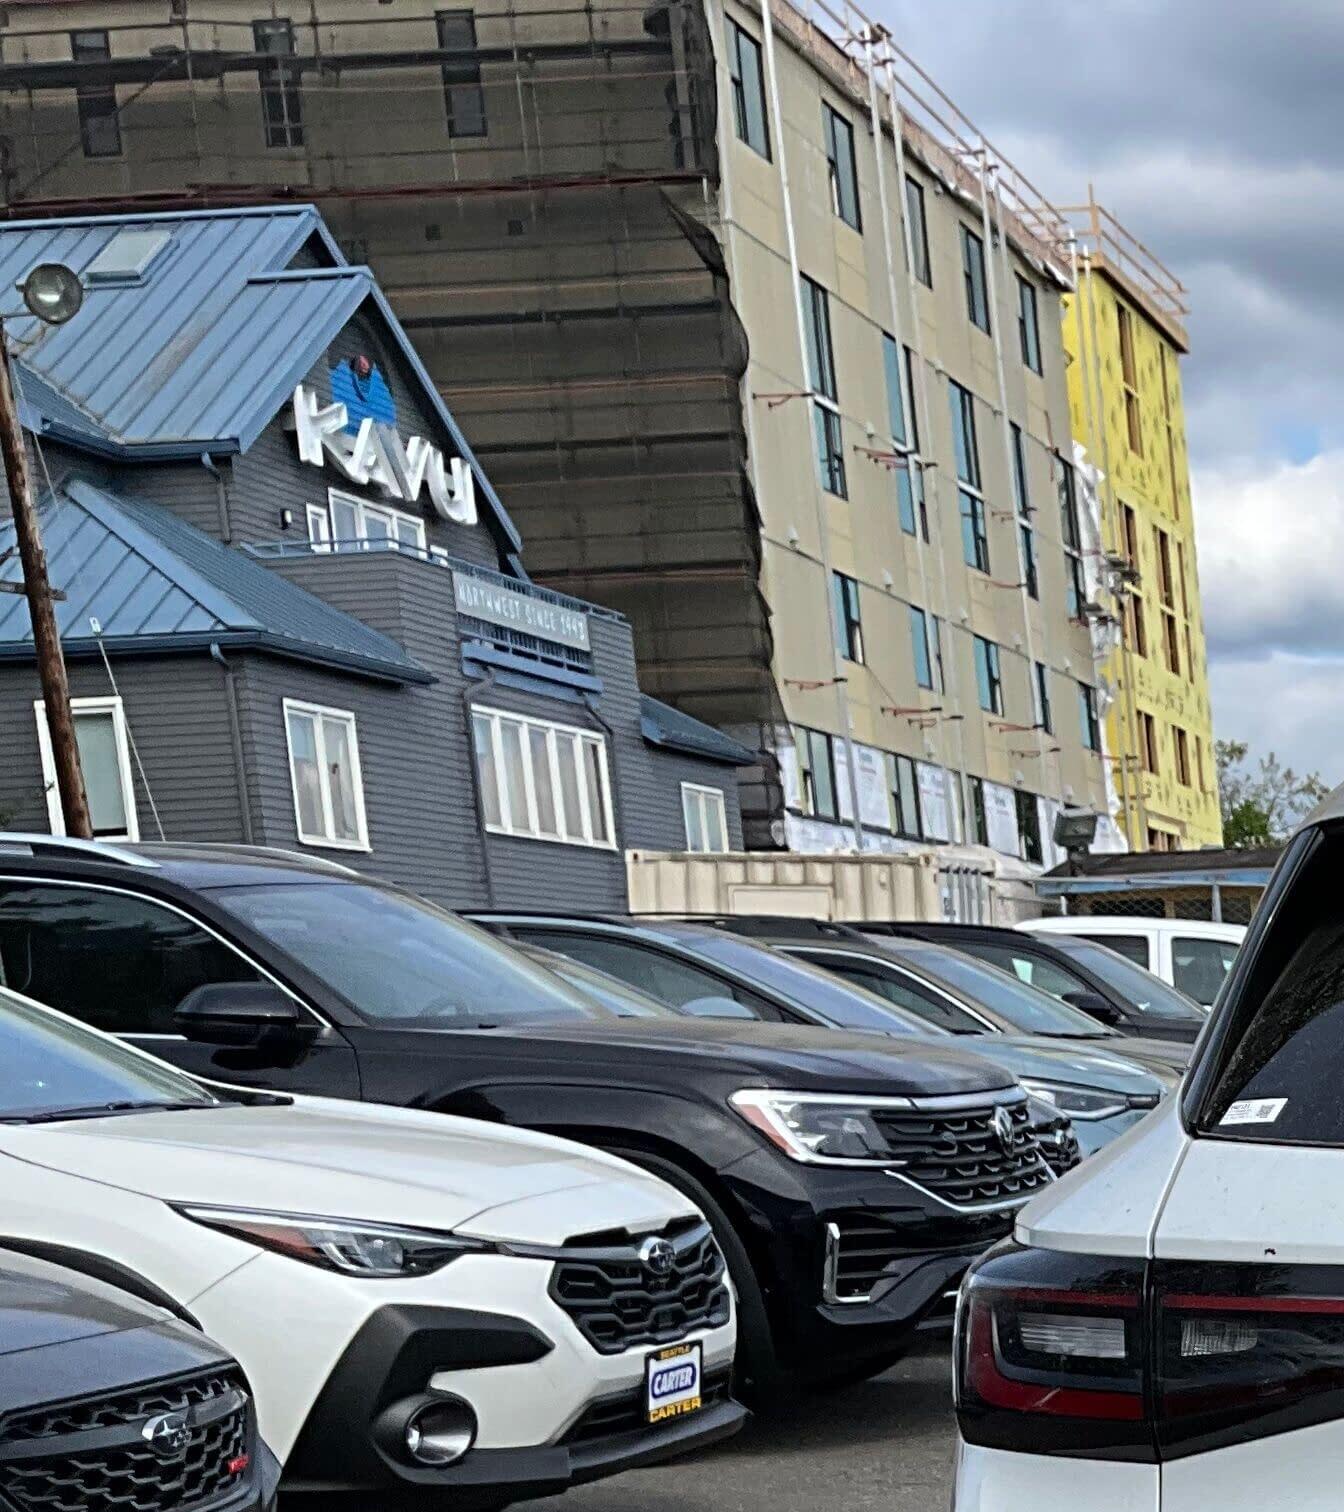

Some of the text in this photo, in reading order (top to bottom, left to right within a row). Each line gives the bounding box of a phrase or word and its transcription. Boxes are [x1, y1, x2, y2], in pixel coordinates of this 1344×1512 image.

[293, 385, 477, 524] KAVU
[653, 1366, 693, 1395] CARTER
[649, 1397, 702, 1423] CARTER
